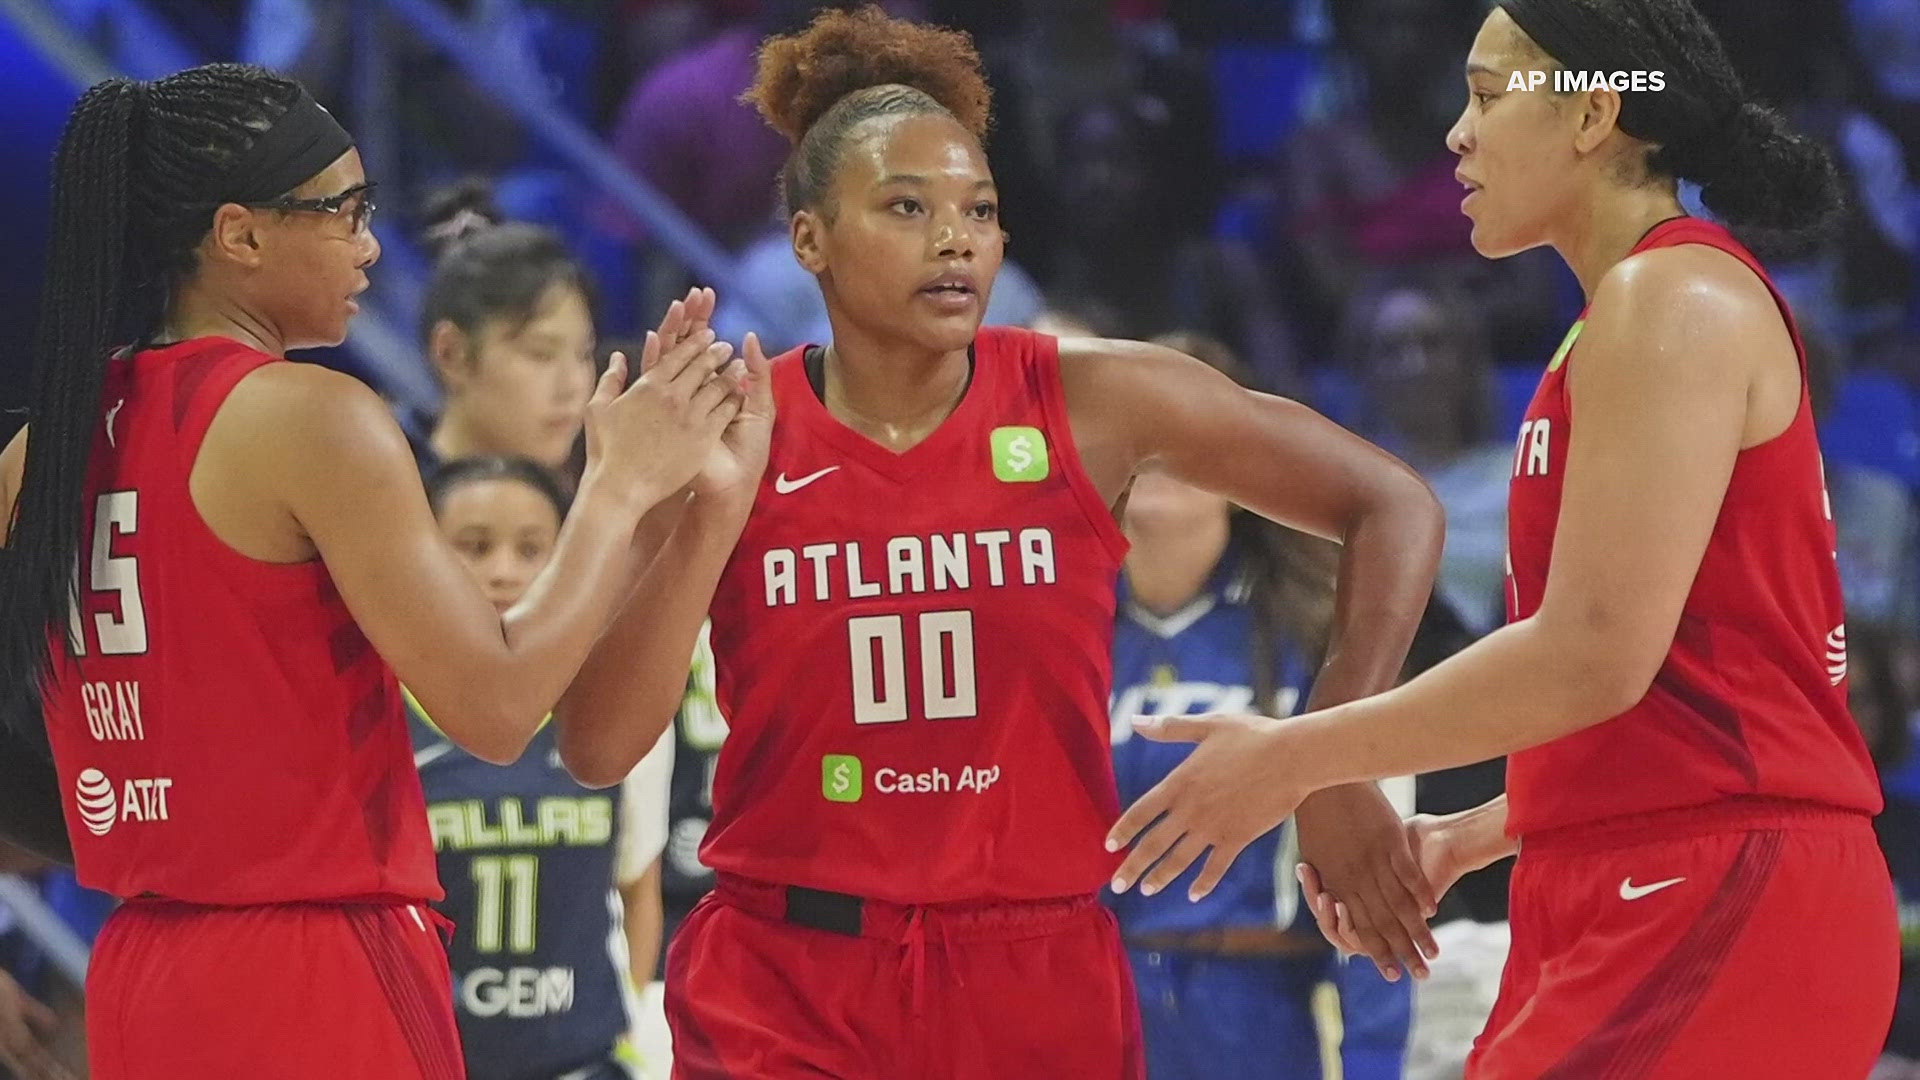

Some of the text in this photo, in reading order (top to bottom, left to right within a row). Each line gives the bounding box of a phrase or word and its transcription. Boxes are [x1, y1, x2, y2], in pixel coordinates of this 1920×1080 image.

[763, 527, 1057, 607] ATLANTA
[848, 610, 977, 725] 00
[81, 681, 145, 741] GRAY
[874, 768, 950, 793] Cash
[428, 796, 613, 853] ALLAS
[473, 855, 538, 954] 11
